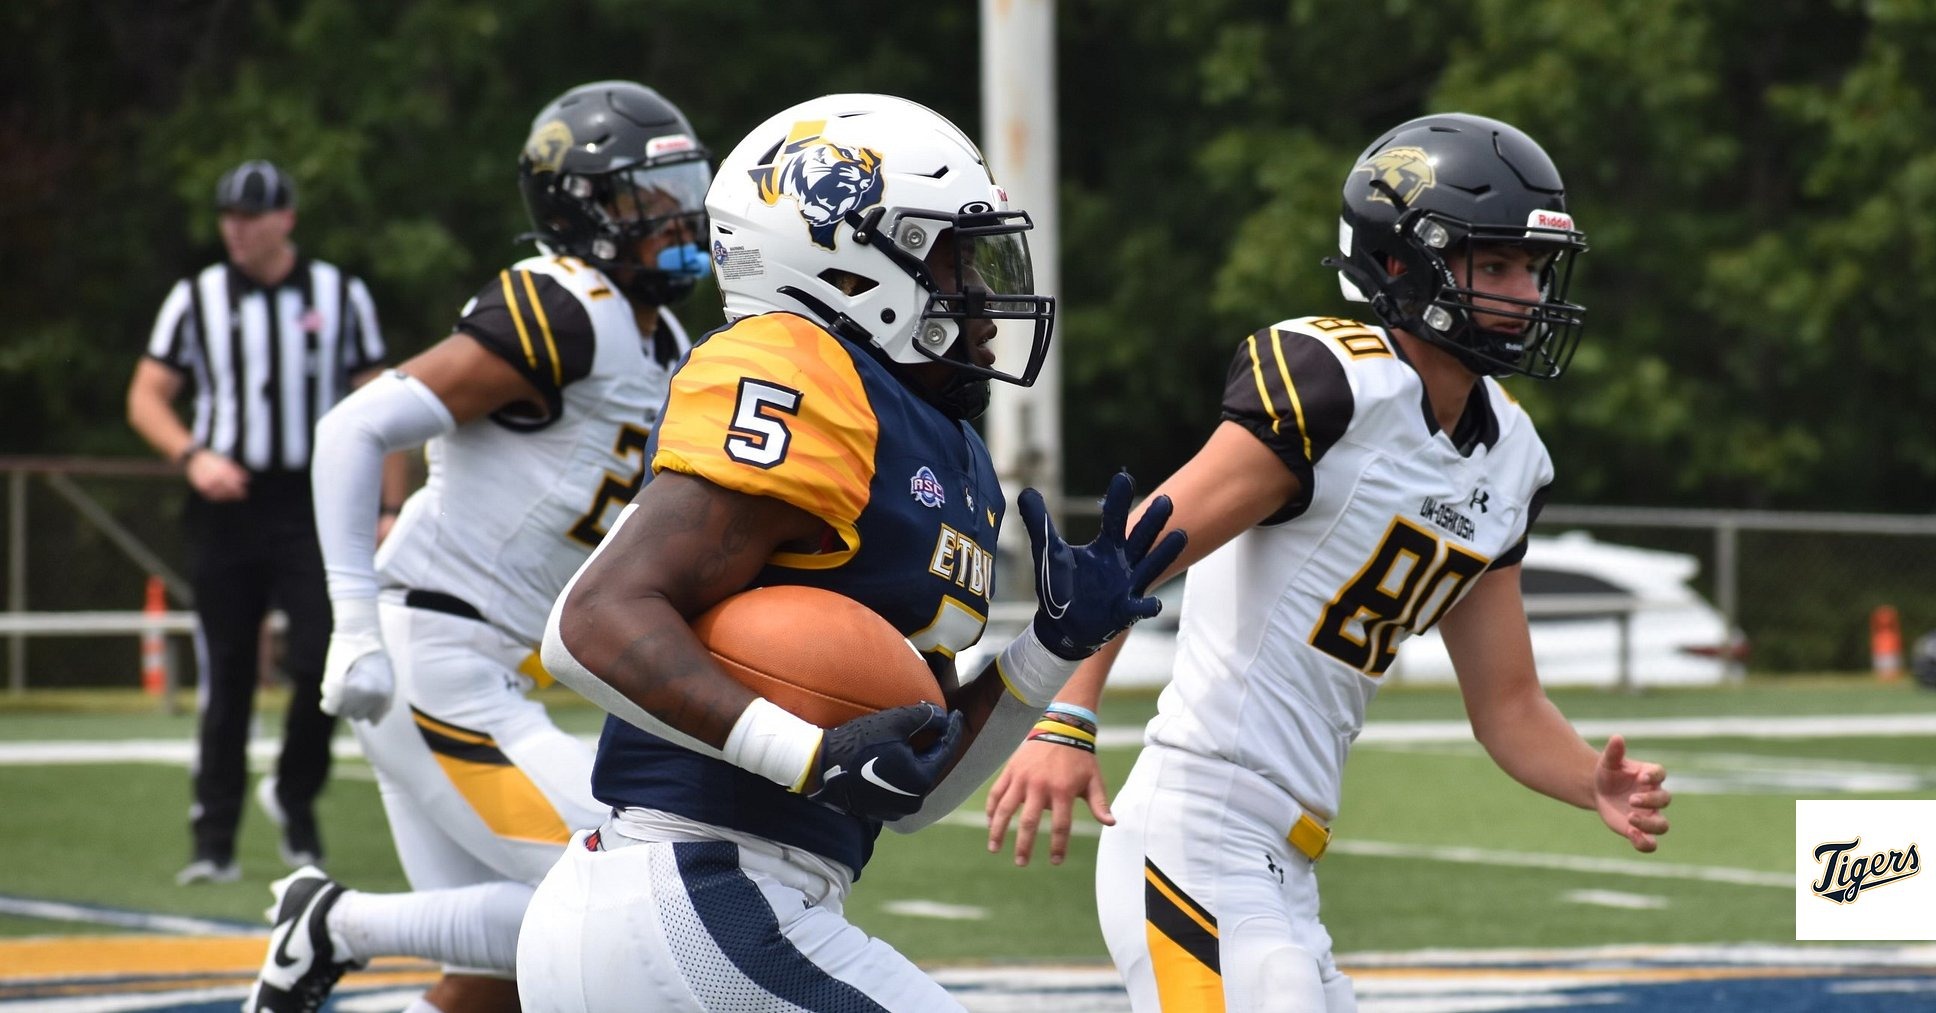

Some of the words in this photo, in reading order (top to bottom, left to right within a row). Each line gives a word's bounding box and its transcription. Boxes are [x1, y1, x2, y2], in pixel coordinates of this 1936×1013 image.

[723, 376, 804, 470] 5
[911, 477, 945, 501] ASC
[1420, 496, 1476, 542] UW-OSHKOSH
[1307, 514, 1494, 677] 80
